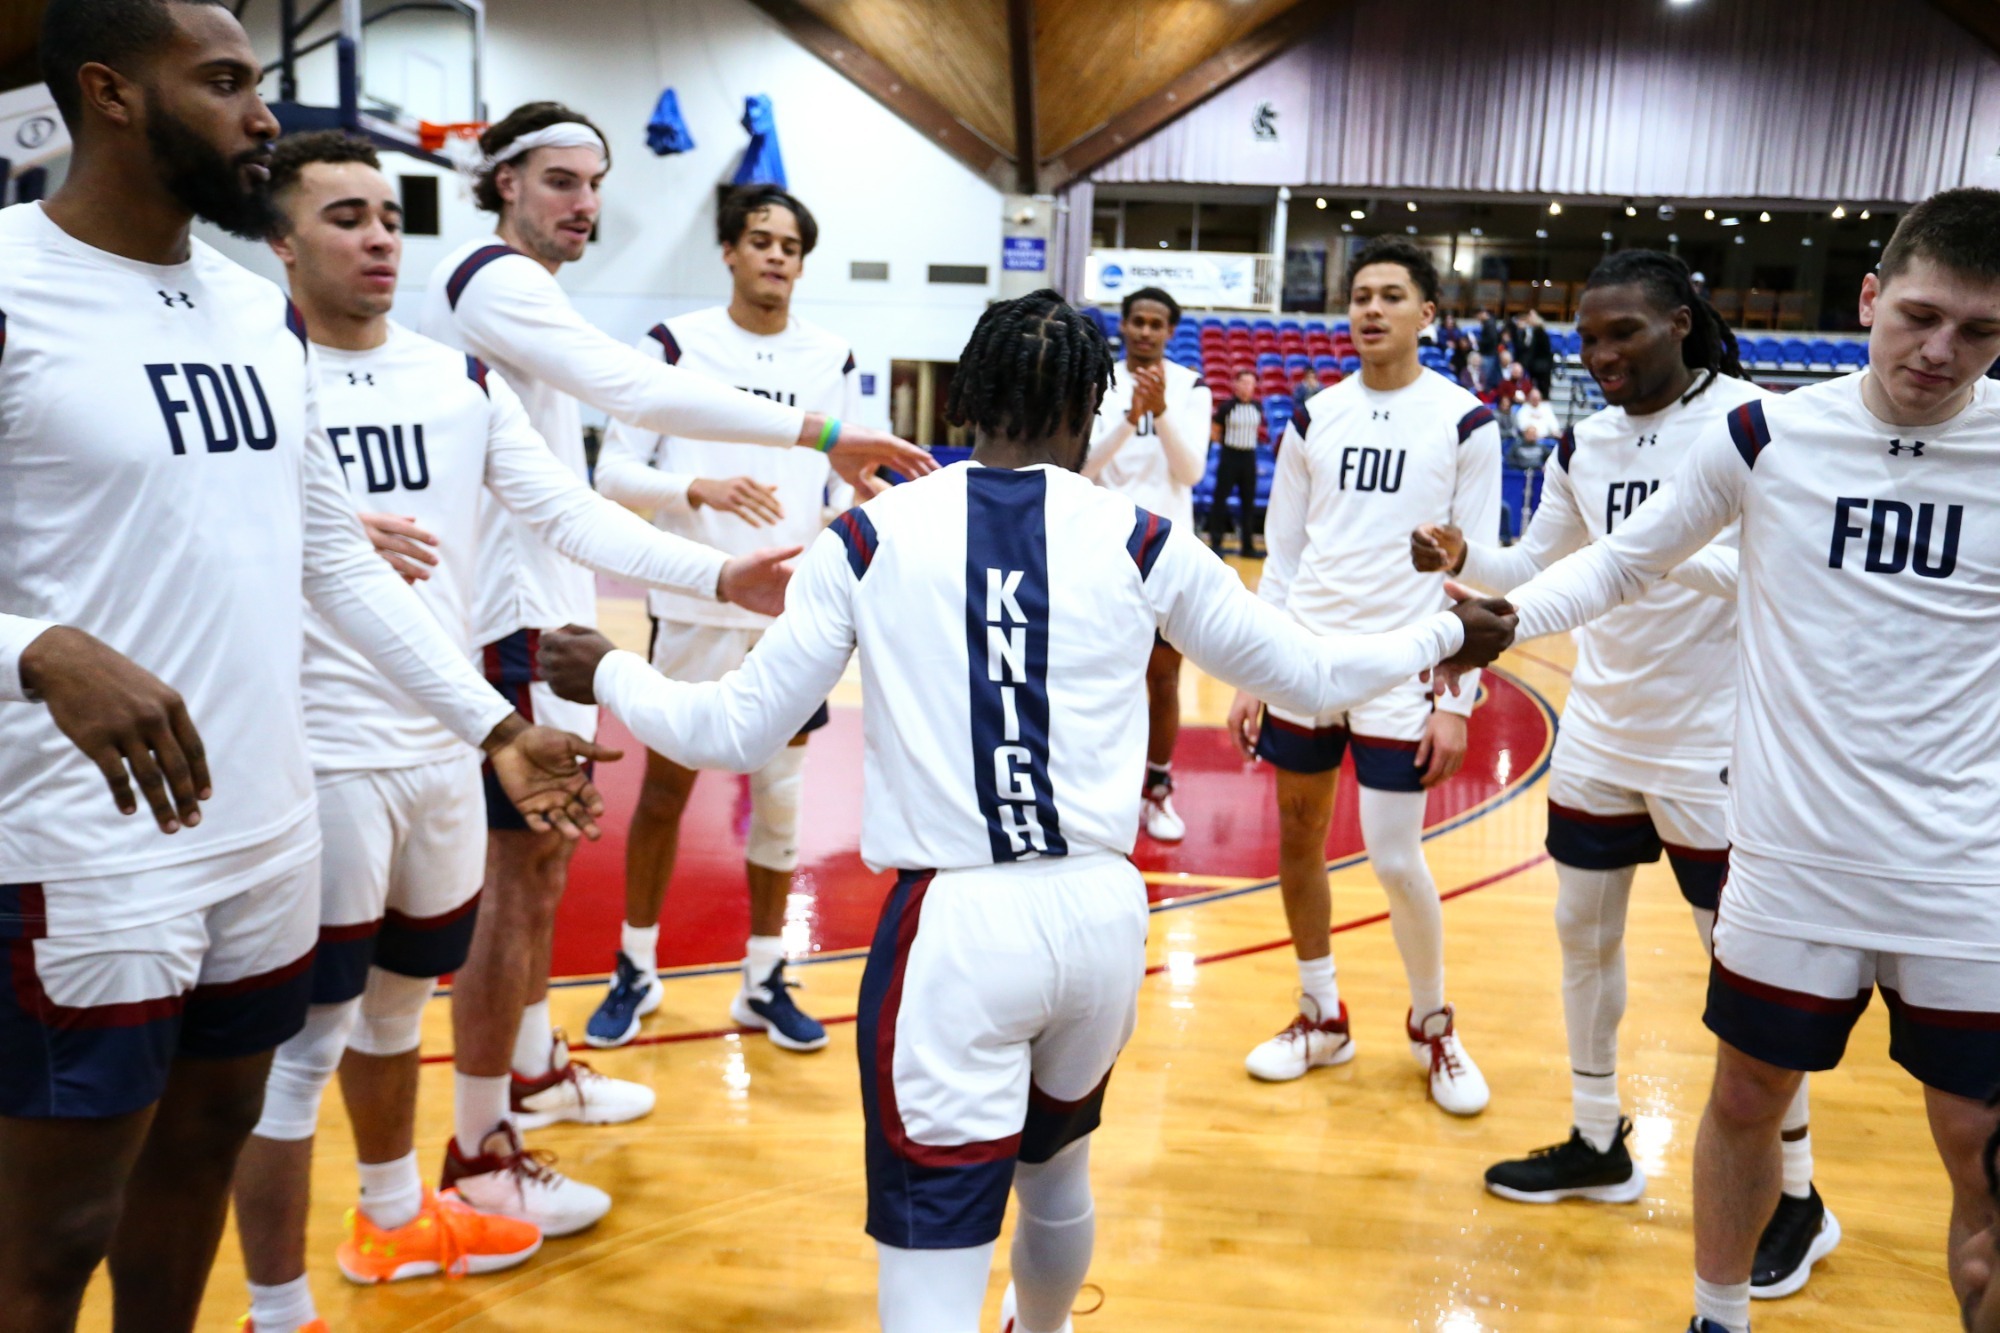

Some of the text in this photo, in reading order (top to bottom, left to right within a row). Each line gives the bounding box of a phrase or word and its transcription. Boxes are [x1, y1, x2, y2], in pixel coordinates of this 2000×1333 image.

[144, 363, 277, 455] FDU
[327, 424, 429, 493] FDU
[1339, 447, 1406, 493] FDU
[1606, 479, 1660, 534] FD
[1828, 496, 1964, 579] FDU
[986, 567, 1048, 861] KNIGH
